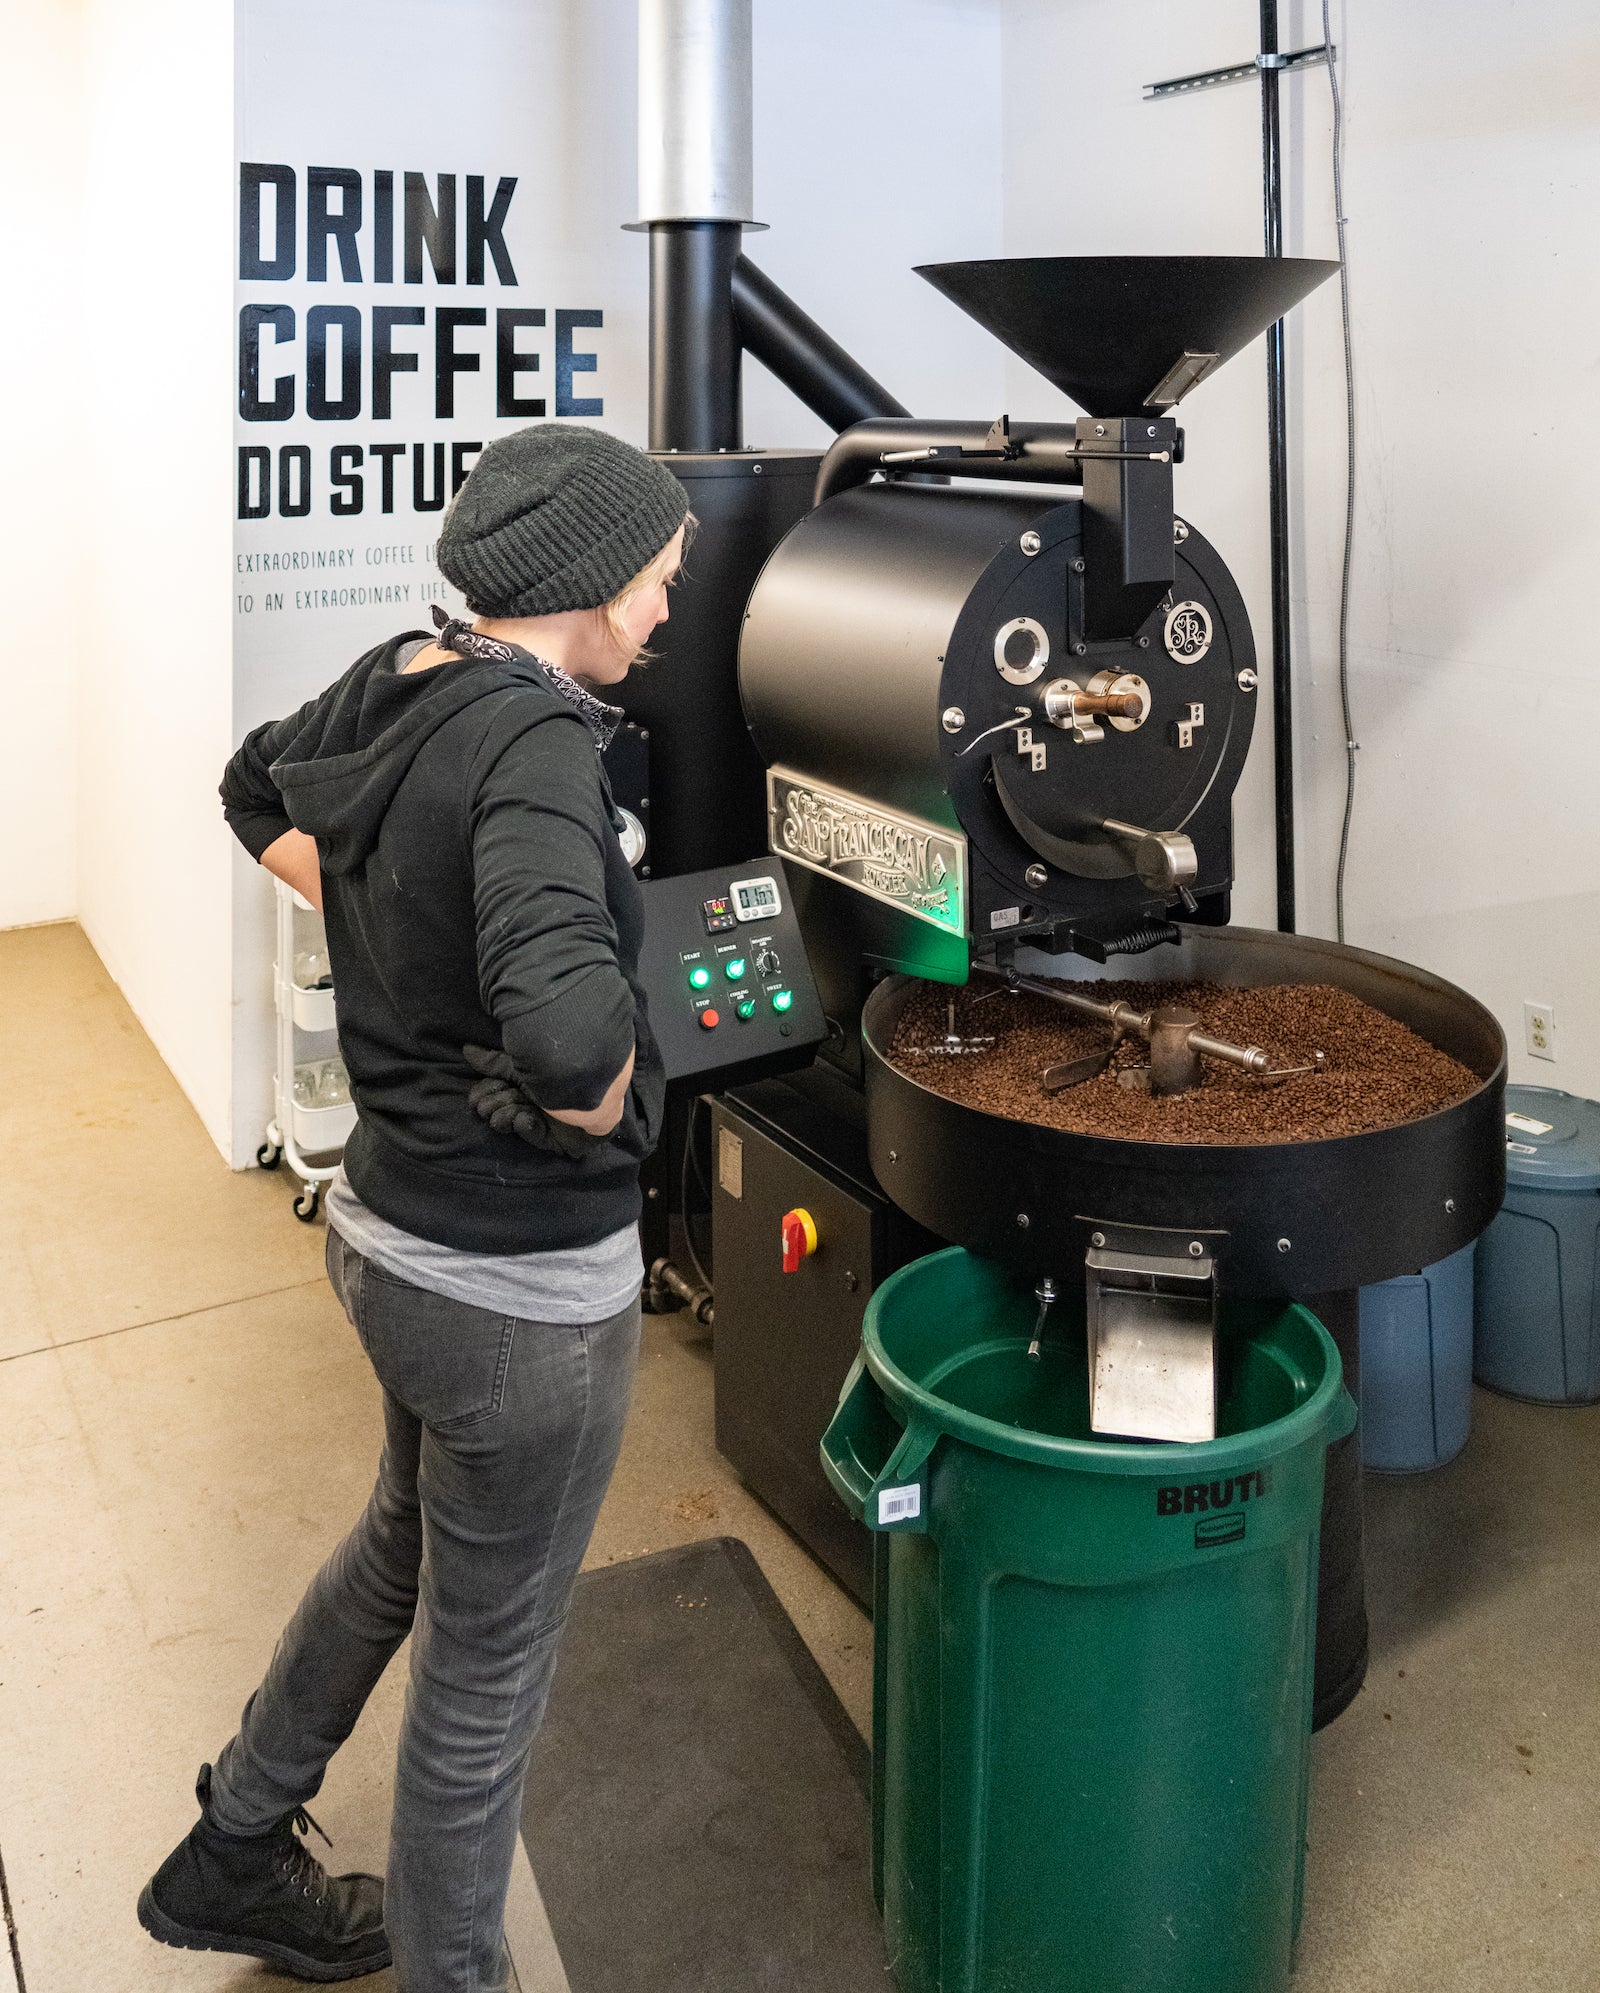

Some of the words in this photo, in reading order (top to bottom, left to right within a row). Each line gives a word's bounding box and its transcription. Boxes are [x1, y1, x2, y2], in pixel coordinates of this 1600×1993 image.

[240, 162, 518, 286] DRINK
[239, 304, 603, 421] COFFEE
[238, 445, 311, 519] DO
[330, 441, 494, 516] STUF
[237, 549, 354, 573] EXTRAORDINARY
[366, 546, 414, 566] COFFEE
[238, 594, 254, 614] TO
[265, 592, 284, 611] AN
[296, 584, 410, 609] EXTRAORDINARY
[421, 581, 448, 601] LIFE
[818, 807, 933, 890] FRANCISCAN
[863, 866, 909, 894] ROASTER
[683, 952, 701, 961] START
[717, 944, 737, 953] BURNER
[766, 983, 783, 992] SWEEP
[695, 999, 710, 1008] STOP
